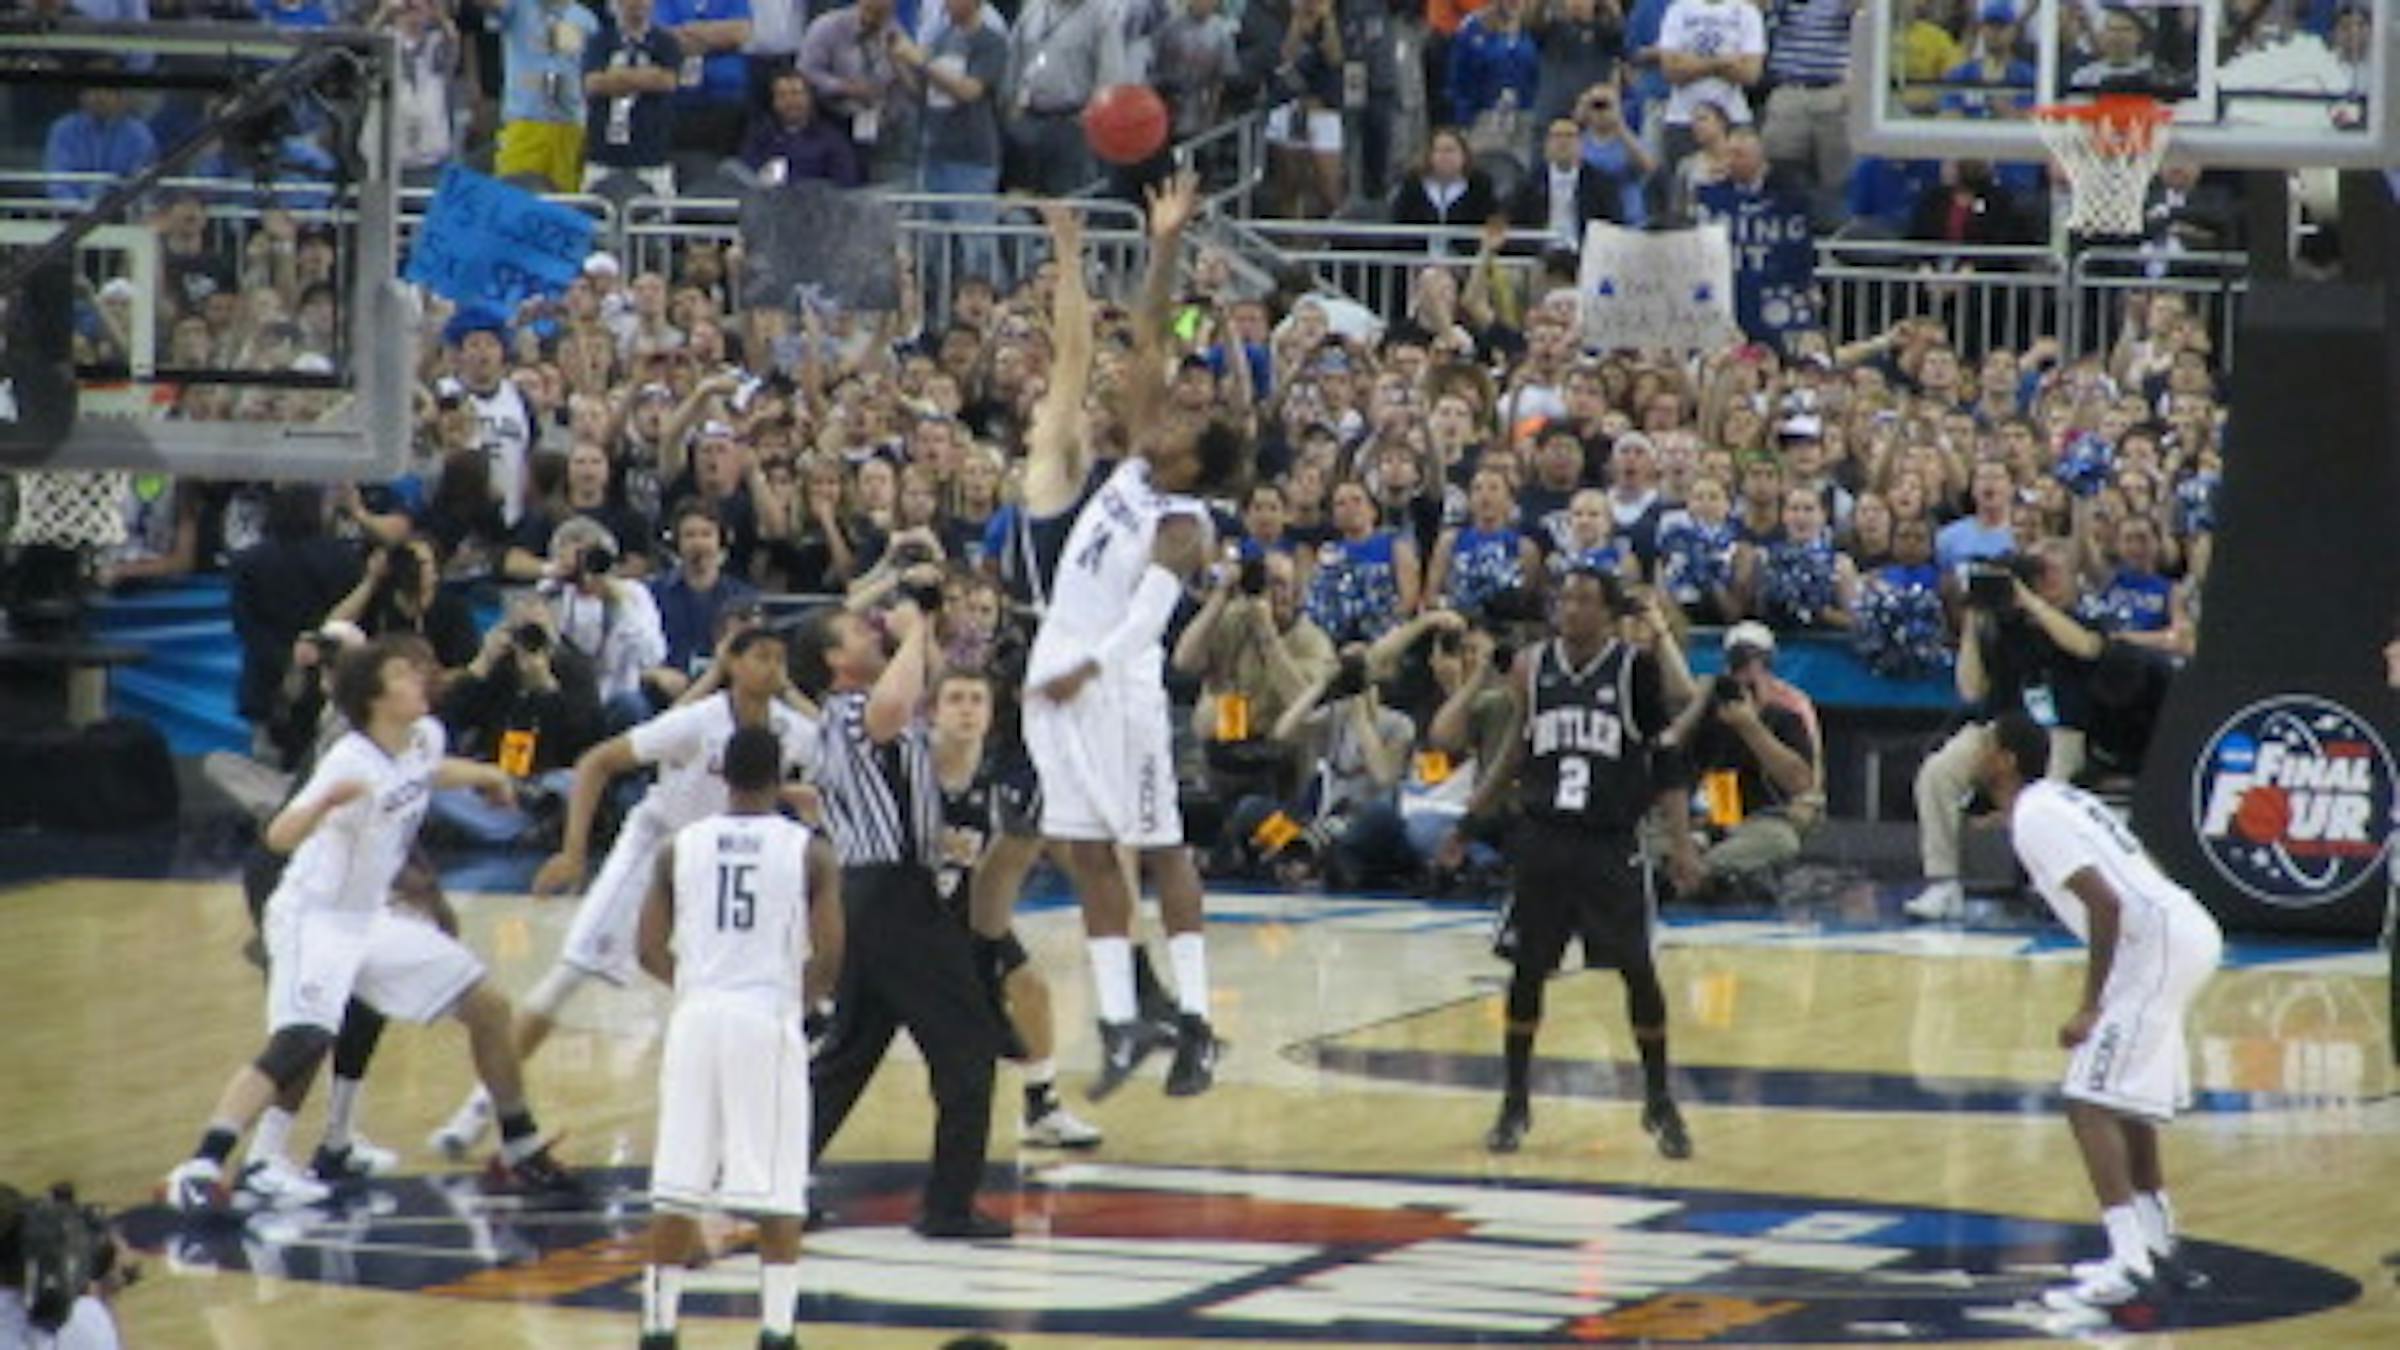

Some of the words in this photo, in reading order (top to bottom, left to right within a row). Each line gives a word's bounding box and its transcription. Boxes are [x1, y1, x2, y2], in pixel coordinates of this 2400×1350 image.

[1553, 756, 1592, 811] 2
[2252, 740, 2372, 791] FINAL
[2202, 774, 2372, 840] FOUR
[717, 863, 759, 932] 15
